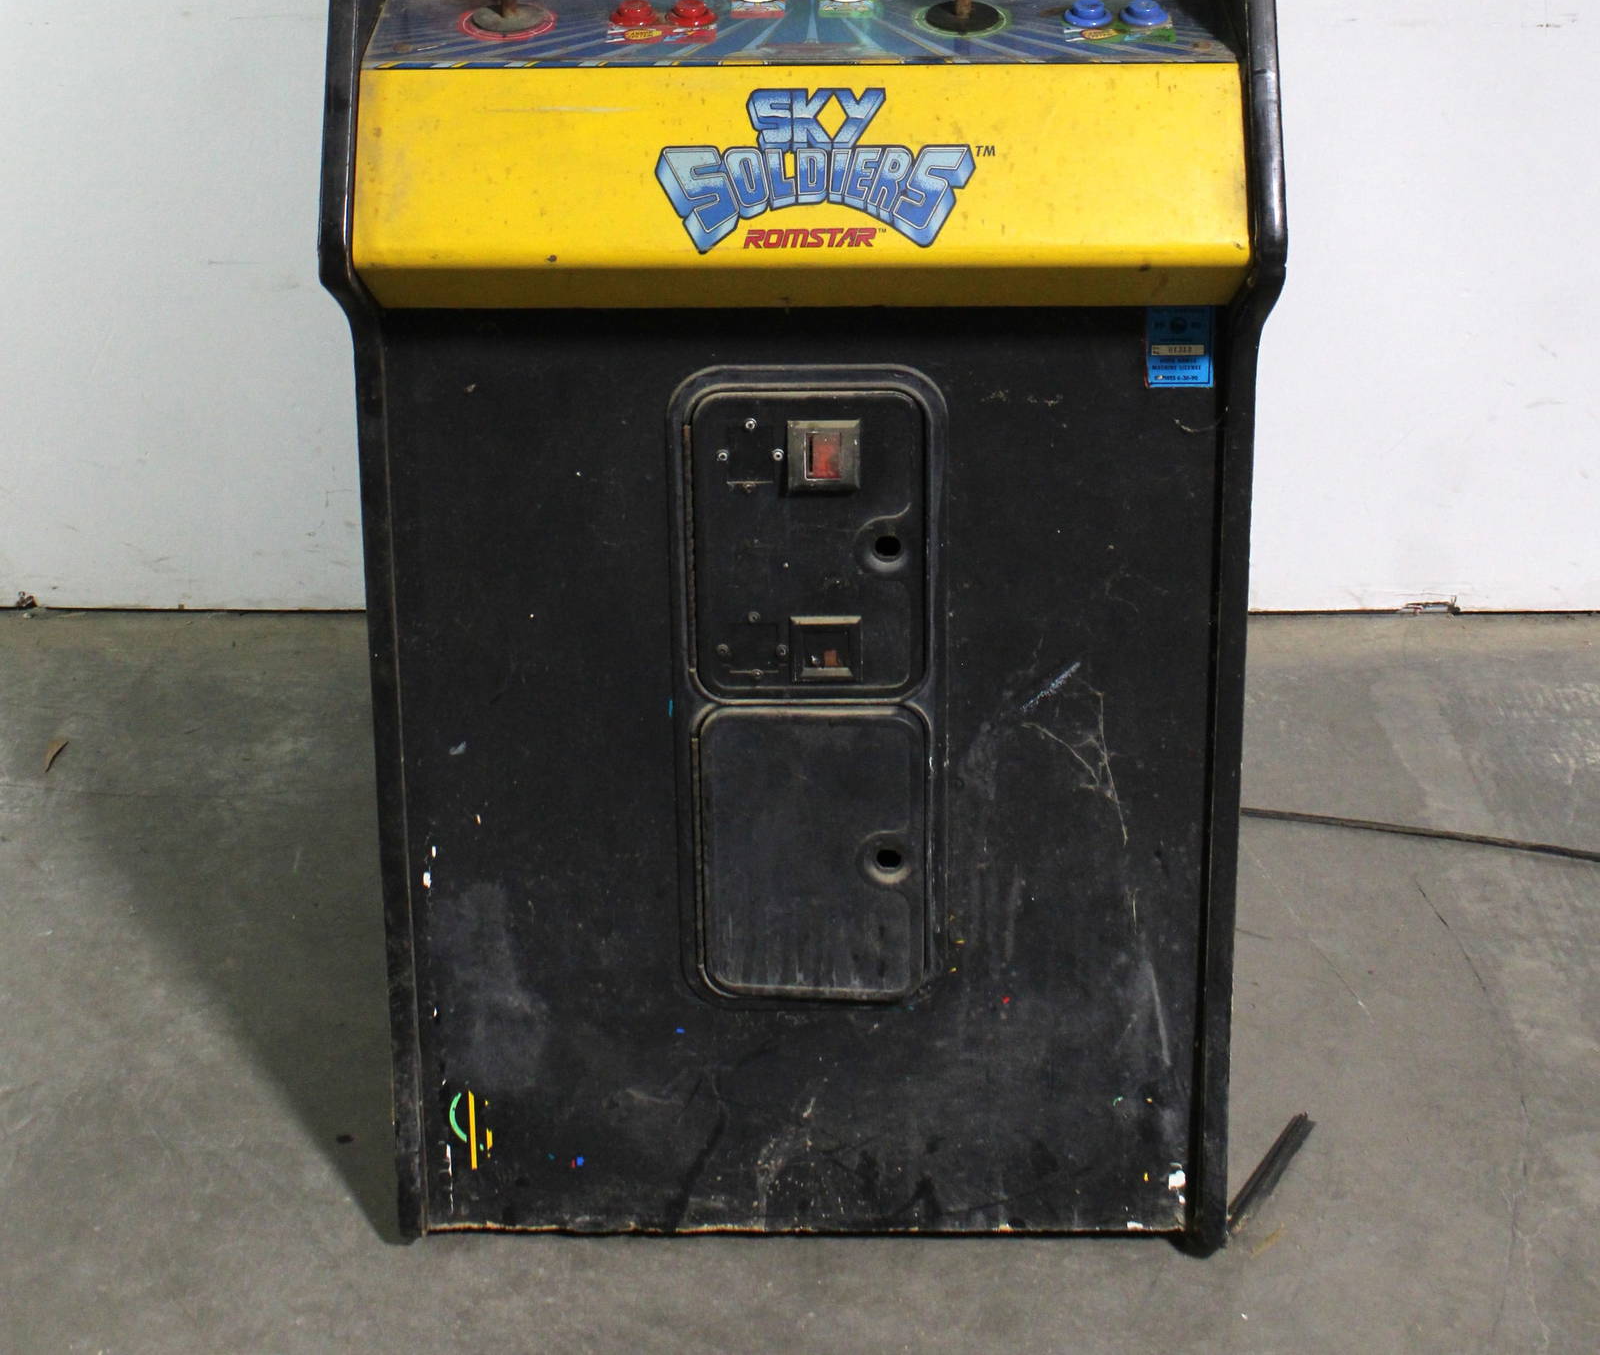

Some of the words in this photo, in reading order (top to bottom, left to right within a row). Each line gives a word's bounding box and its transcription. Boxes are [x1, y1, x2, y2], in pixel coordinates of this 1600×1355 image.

[746, 87, 886, 148] SKY
[654, 143, 977, 255] SOLDIERS
[743, 228, 877, 249] ROMSTAR
